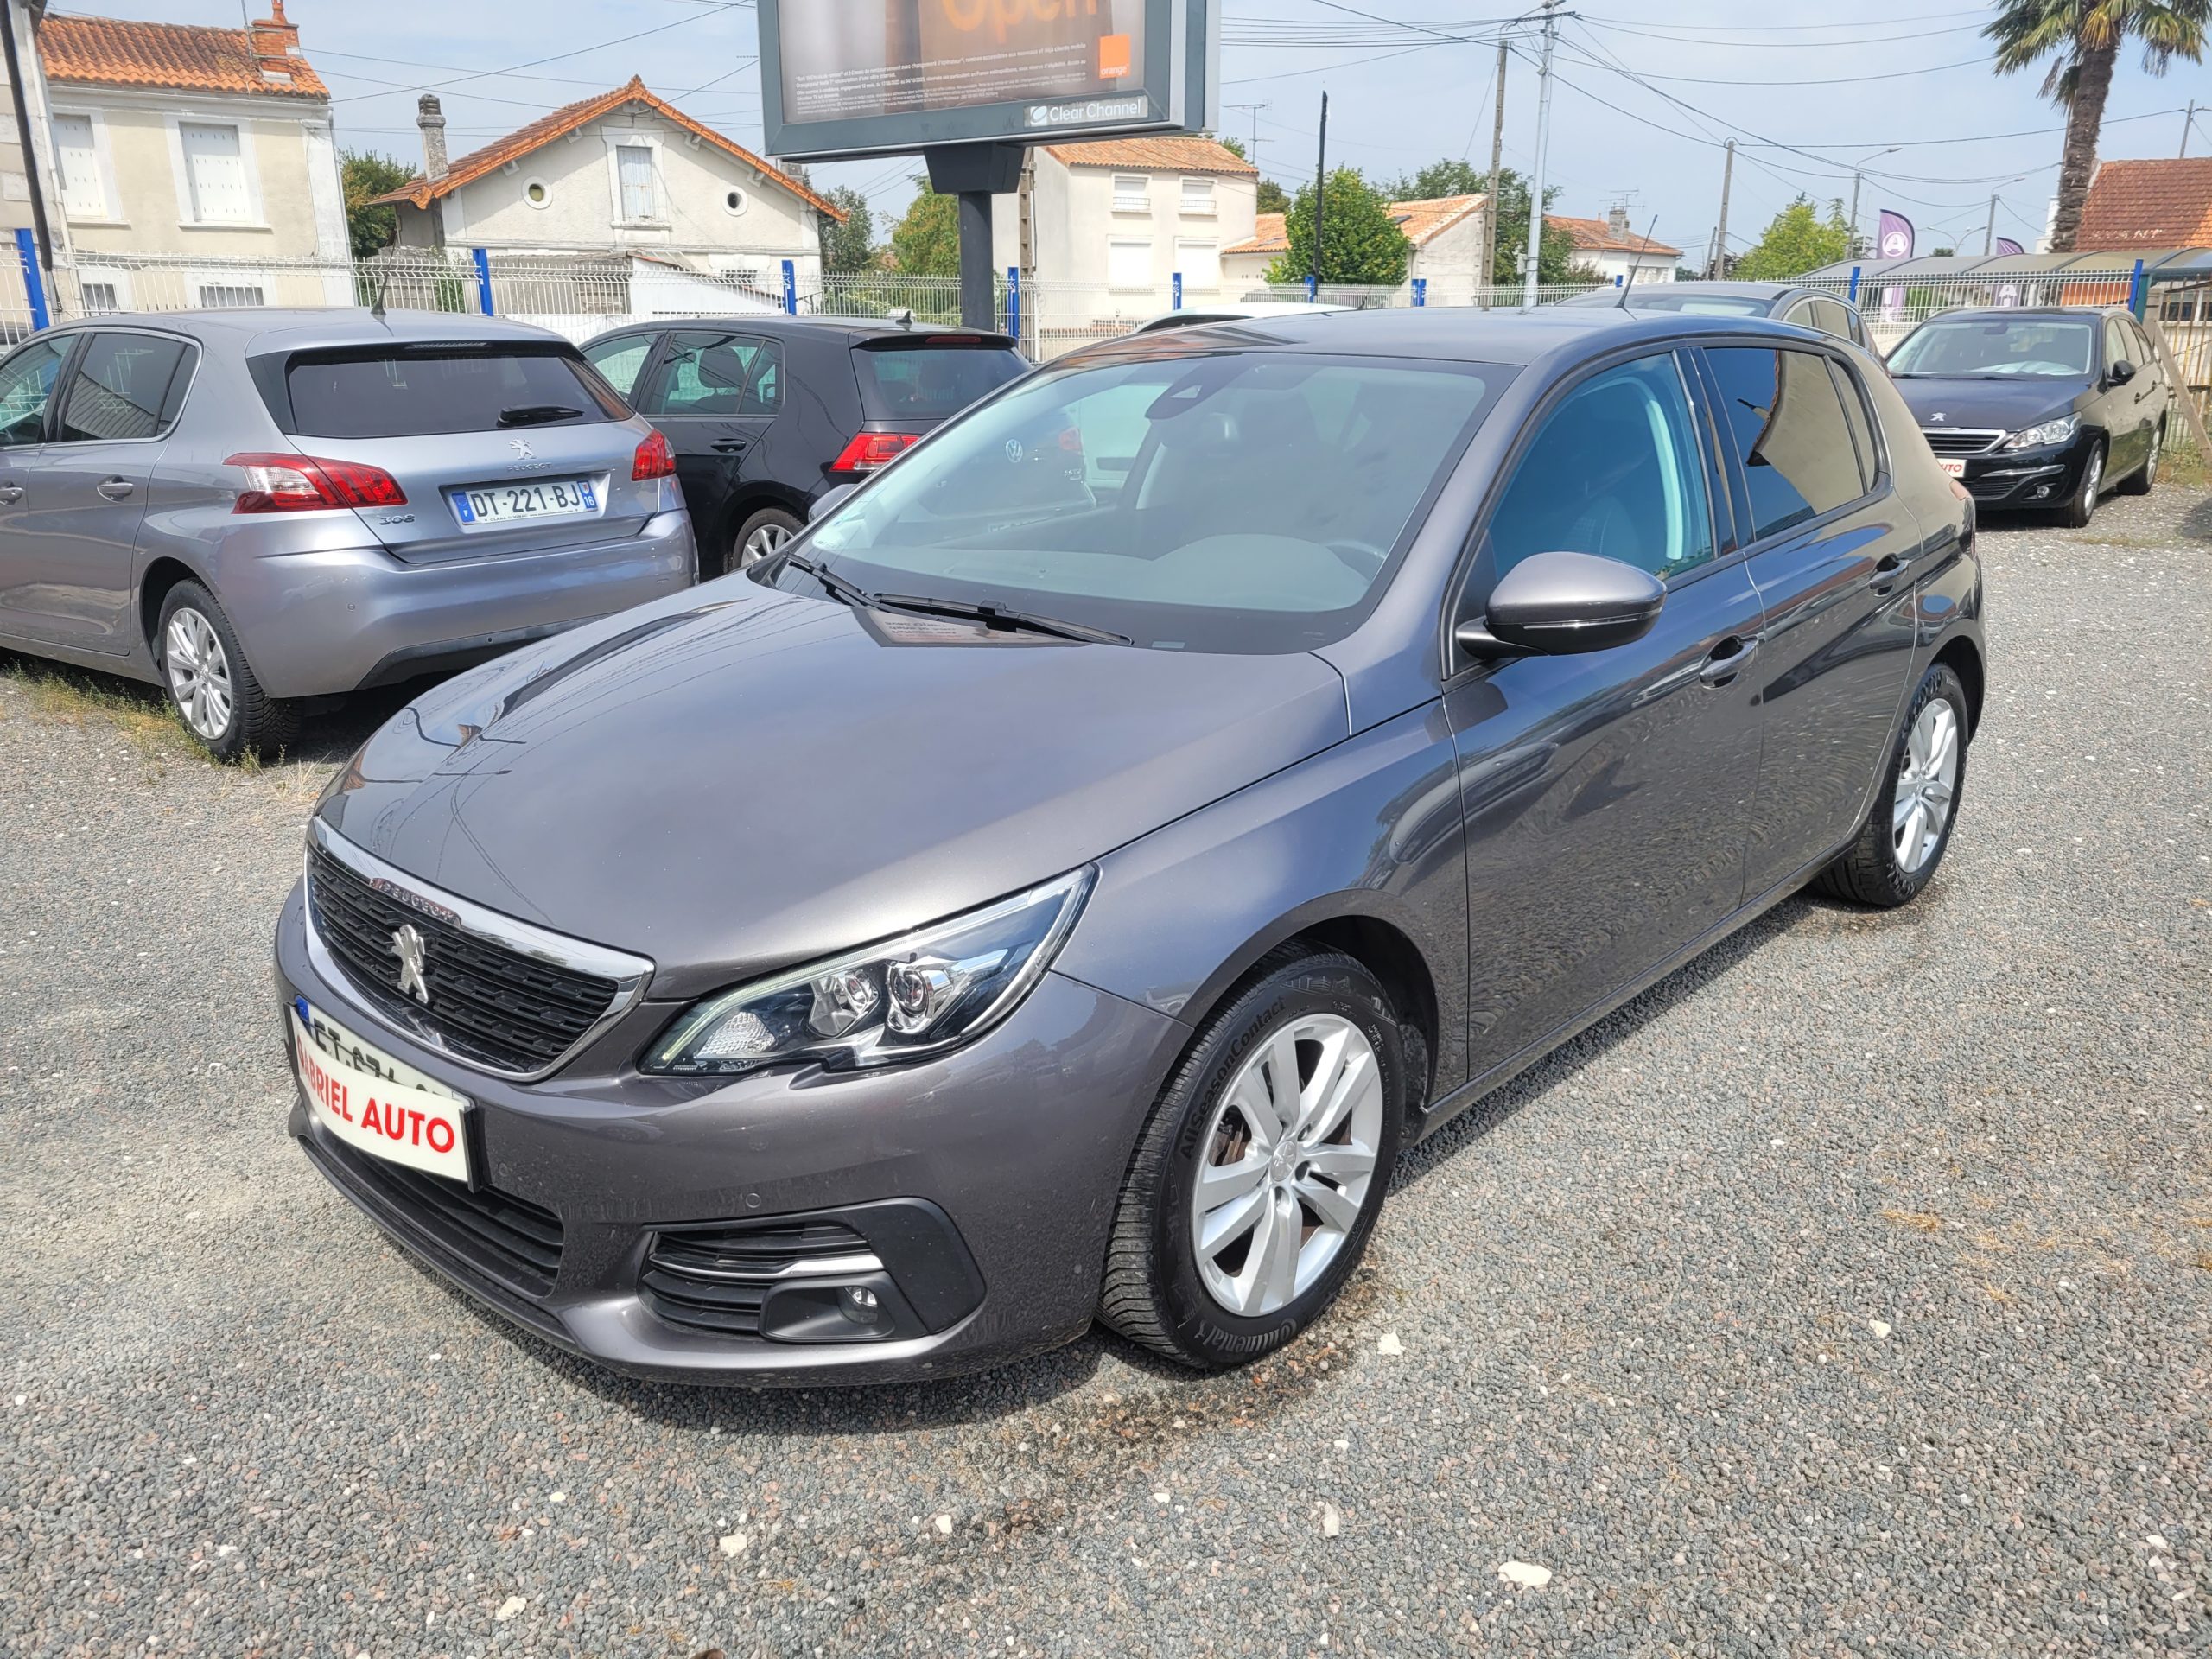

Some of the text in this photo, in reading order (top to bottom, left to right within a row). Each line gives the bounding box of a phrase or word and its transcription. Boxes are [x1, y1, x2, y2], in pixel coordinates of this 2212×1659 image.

[1100, 66, 1128, 76] orange
[1049, 98, 1141, 121] Clear Channel
[1941, 464, 1962, 473] UTO
[470, 484, 581, 518] DT-221-BJ
[583, 495, 595, 507] 16
[379, 513, 415, 525] 308
[463, 509, 469, 518] F
[296, 1033, 455, 1154] GABRIEL AUTO
[1202, 1318, 1298, 1353] Continental
